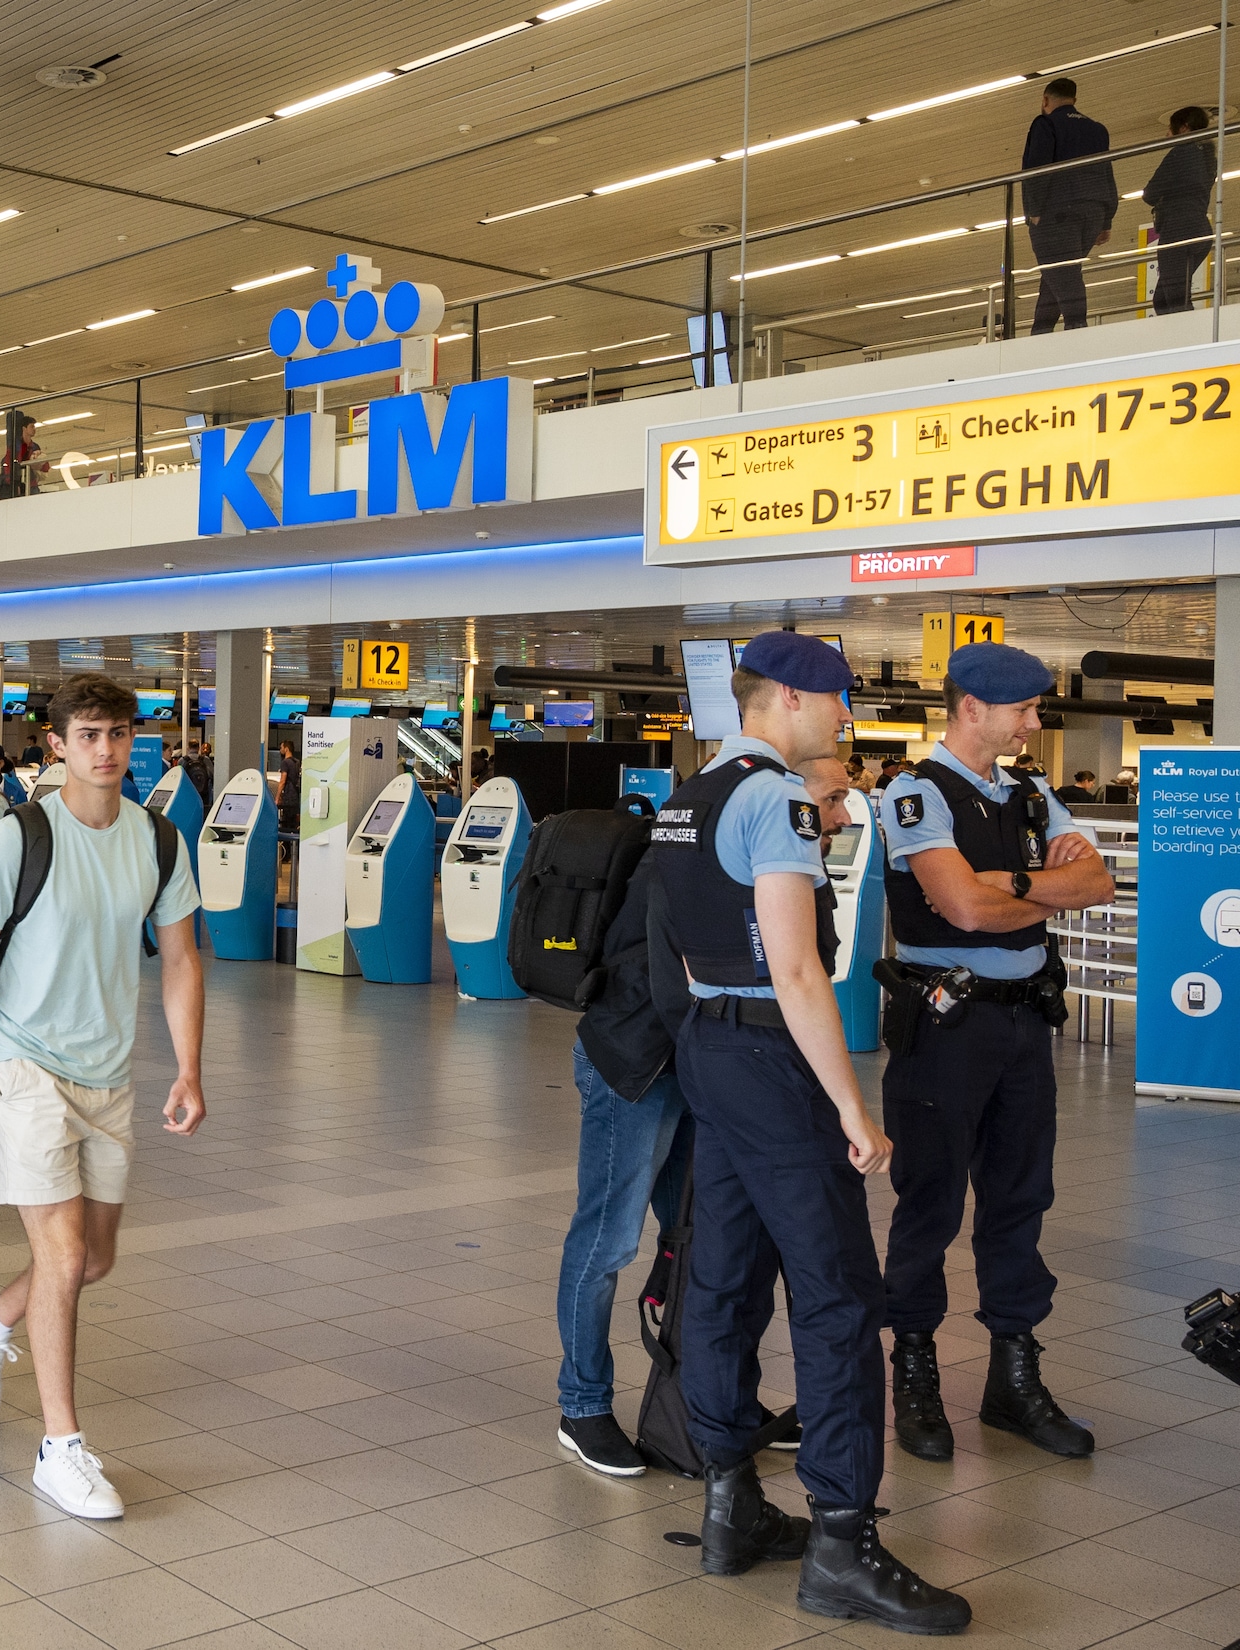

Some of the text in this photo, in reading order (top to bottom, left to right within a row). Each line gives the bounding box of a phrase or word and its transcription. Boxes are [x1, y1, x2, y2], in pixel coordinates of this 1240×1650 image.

[961, 377, 1232, 439] Check-in 17-32
[744, 424, 874, 462] Departures 3
[197, 375, 510, 537] KLM
[743, 457, 795, 475] Vertrek
[743, 488, 892, 525] Gates D 1-57
[929, 618, 943, 630] 11
[963, 620, 993, 644] 11
[346, 643, 355, 653] 12
[370, 645, 400, 675] 12
[376, 677, 402, 687] Check-in
[307, 731, 324, 739] Hand
[307, 740, 334, 748] Sanitiser
[1153, 767, 1183, 776] KLM
[1188, 767, 1218, 778] Royal
[1152, 789, 1199, 802] Please
[1203, 792, 1230, 803] use
[1152, 806, 1233, 820] self-service
[1152, 823, 1168, 836] to
[1172, 823, 1225, 837] retrieve
[1152, 840, 1214, 857] boarding
[749, 921, 765, 962] HOFMAN
